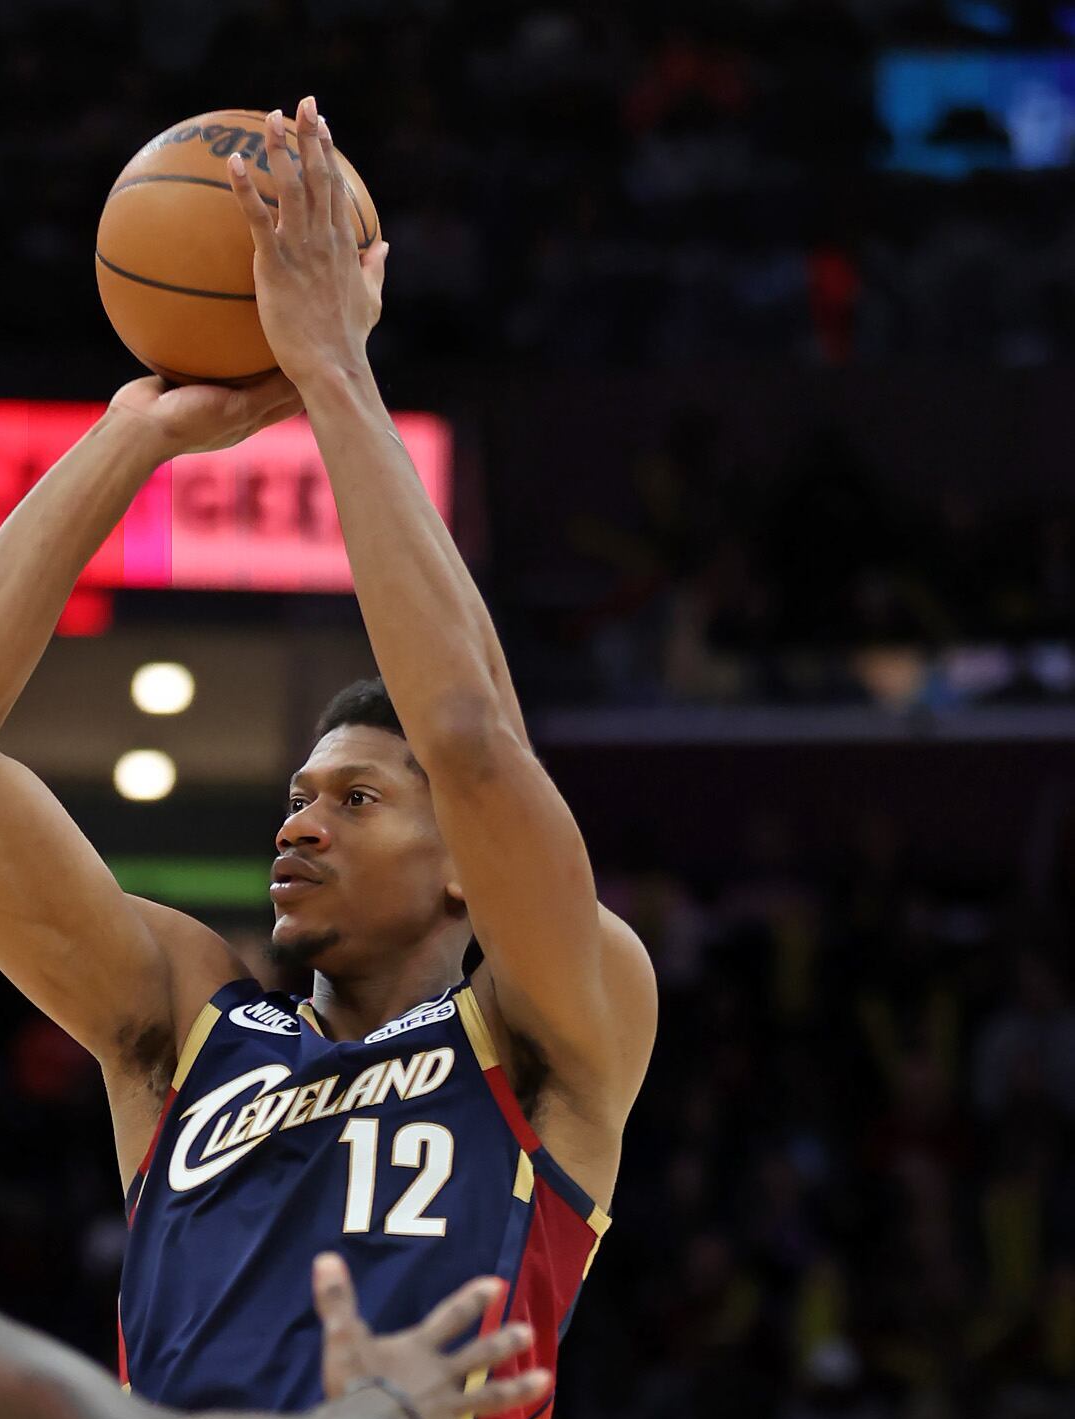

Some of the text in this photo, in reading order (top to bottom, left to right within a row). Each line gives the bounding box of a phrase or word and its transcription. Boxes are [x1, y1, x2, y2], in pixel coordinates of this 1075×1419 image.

[245, 1000, 298, 1030] NIKE
[368, 1004, 453, 1041] CLIFFS
[167, 1046, 456, 1193] CLEVELAND
[337, 1116, 455, 1238] 12
